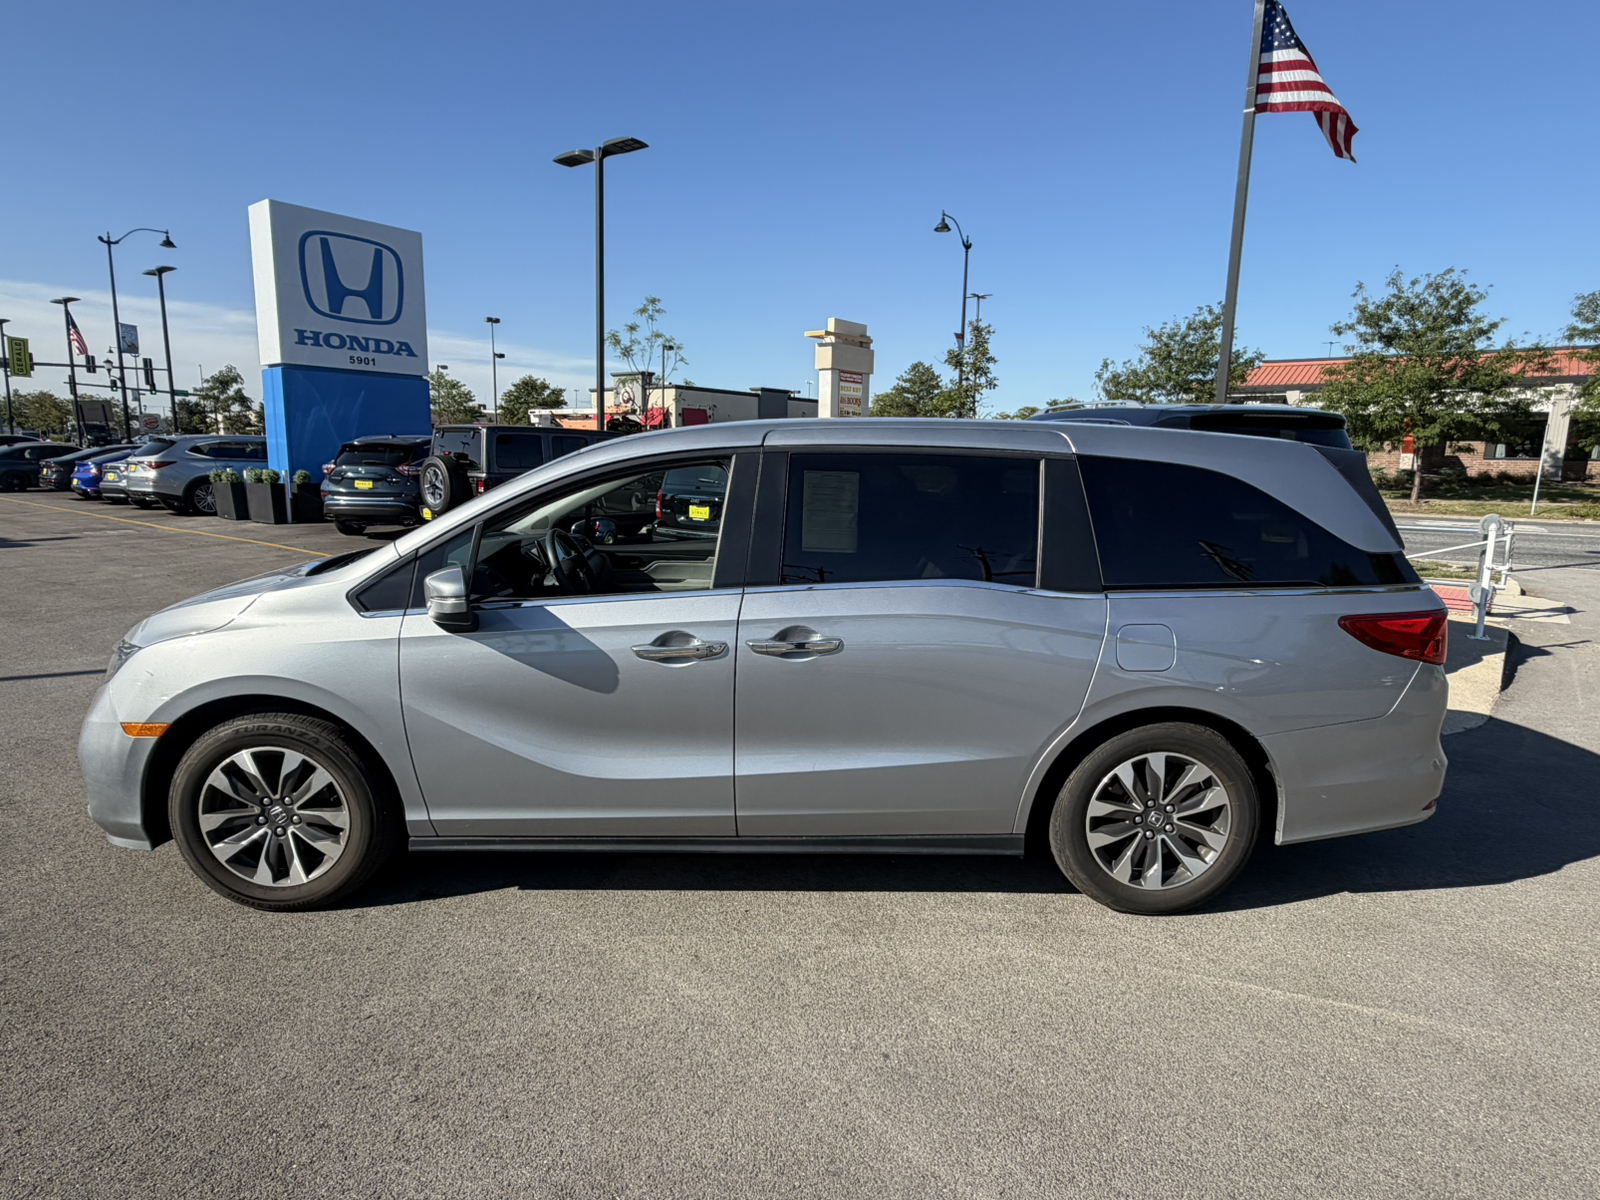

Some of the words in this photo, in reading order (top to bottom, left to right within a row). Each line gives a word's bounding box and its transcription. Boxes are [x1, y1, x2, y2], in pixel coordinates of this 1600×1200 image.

[293, 328, 419, 358] HONDA
[14, 341, 25, 373] GERALD
[348, 355, 376, 366] 5901
[231, 724, 320, 745] TURANZA
